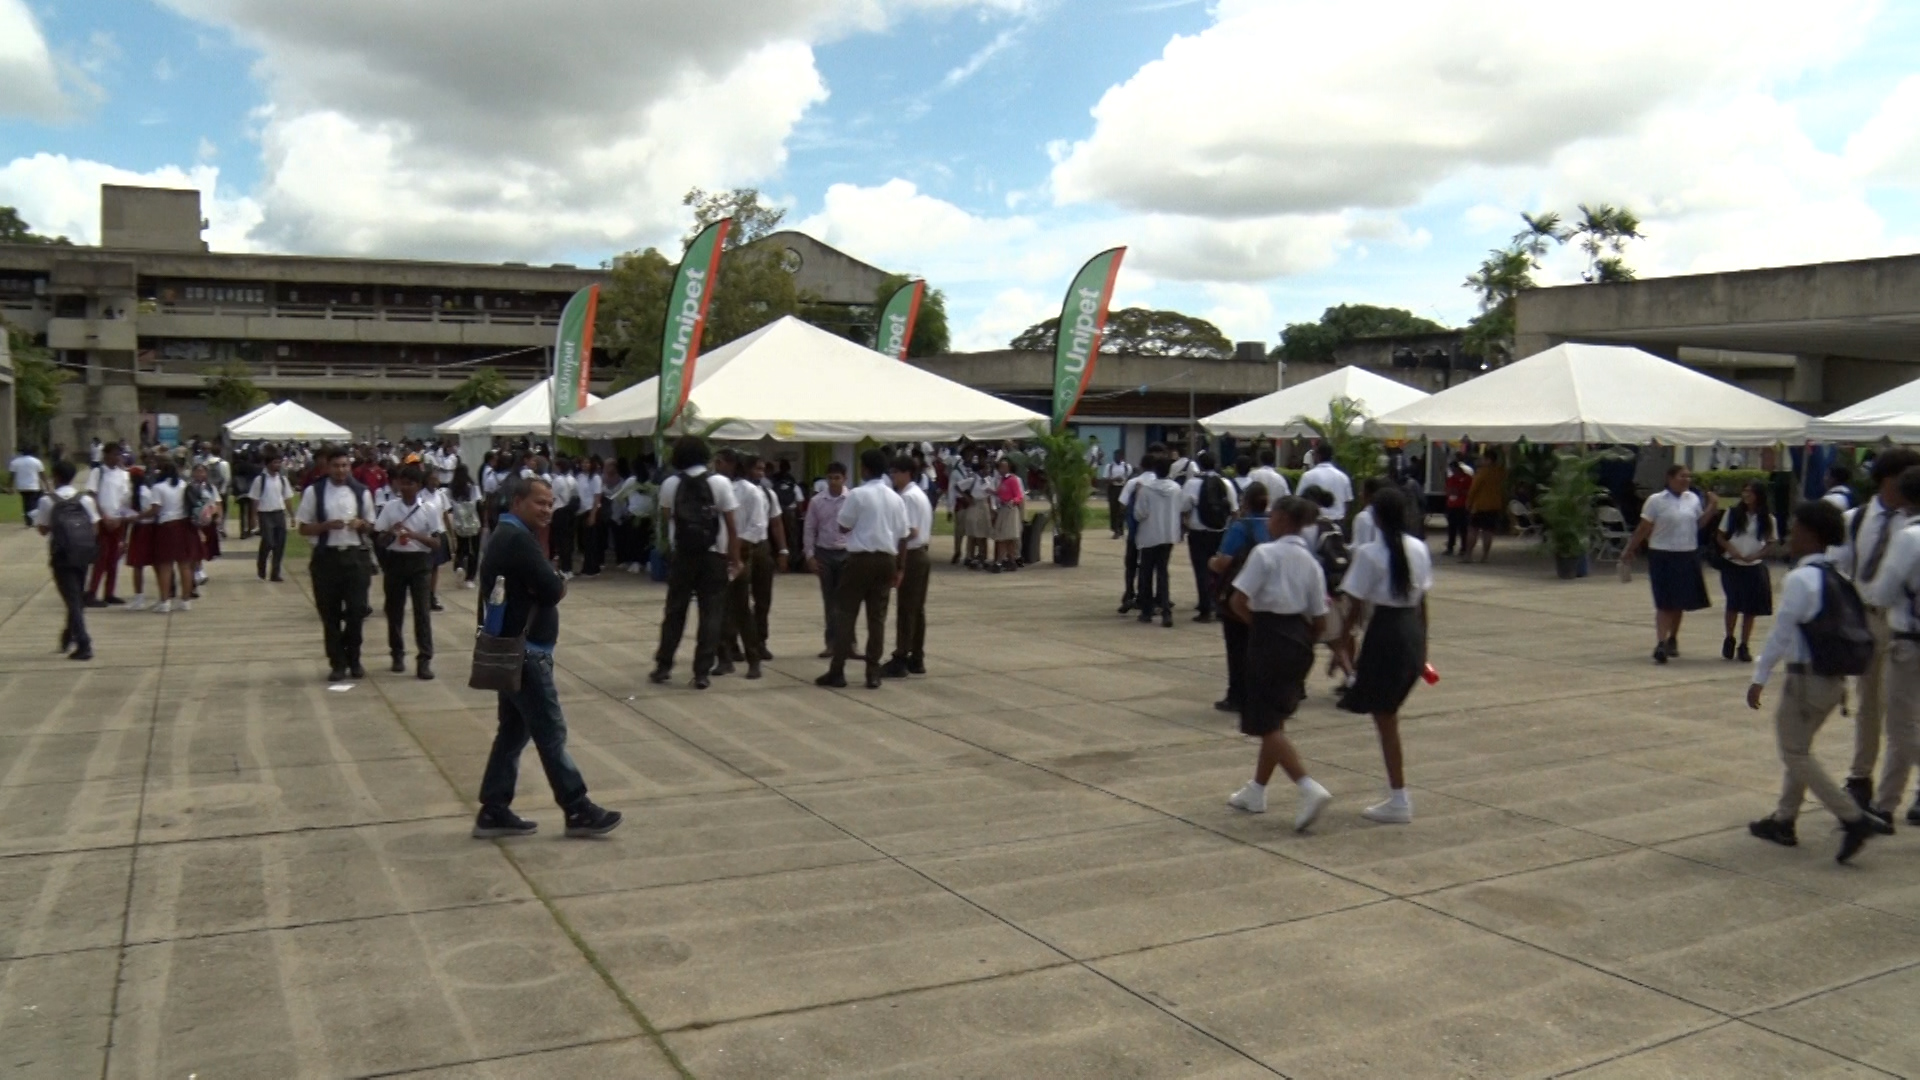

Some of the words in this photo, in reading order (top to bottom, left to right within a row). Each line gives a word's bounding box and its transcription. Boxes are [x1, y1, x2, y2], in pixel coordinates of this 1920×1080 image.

[670, 267, 705, 366] Unipet
[884, 314, 907, 359] ipet
[1064, 287, 1101, 373] Unipet
